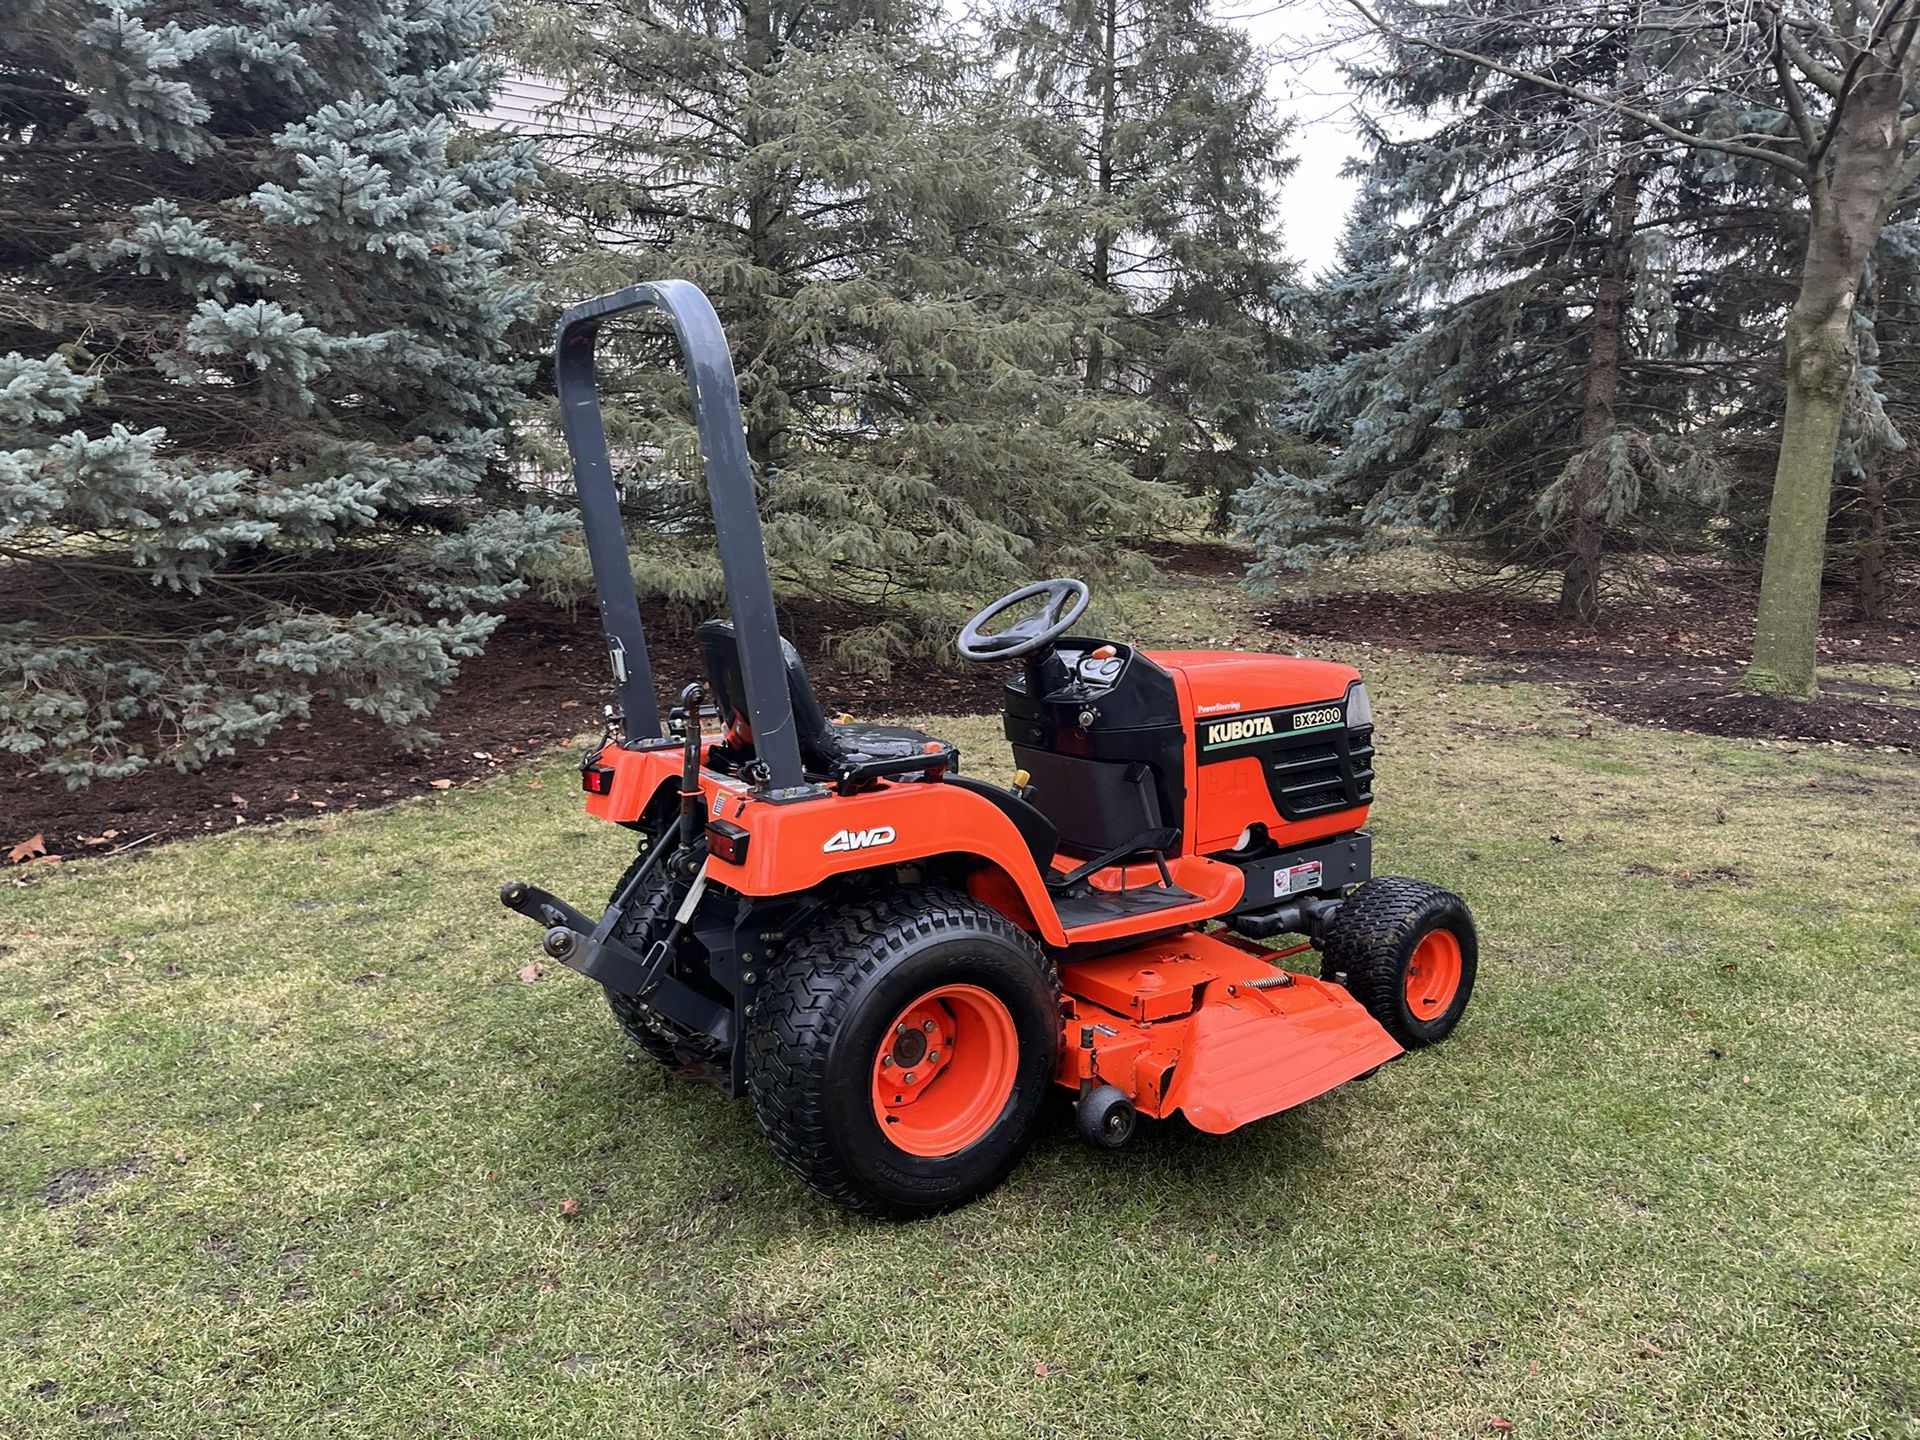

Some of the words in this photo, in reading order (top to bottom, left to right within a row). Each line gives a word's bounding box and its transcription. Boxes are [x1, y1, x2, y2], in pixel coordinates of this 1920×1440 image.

[1208, 716, 1274, 744] KUBOTA
[1293, 707, 1341, 729] BX2200
[823, 826, 896, 853] 4WD
